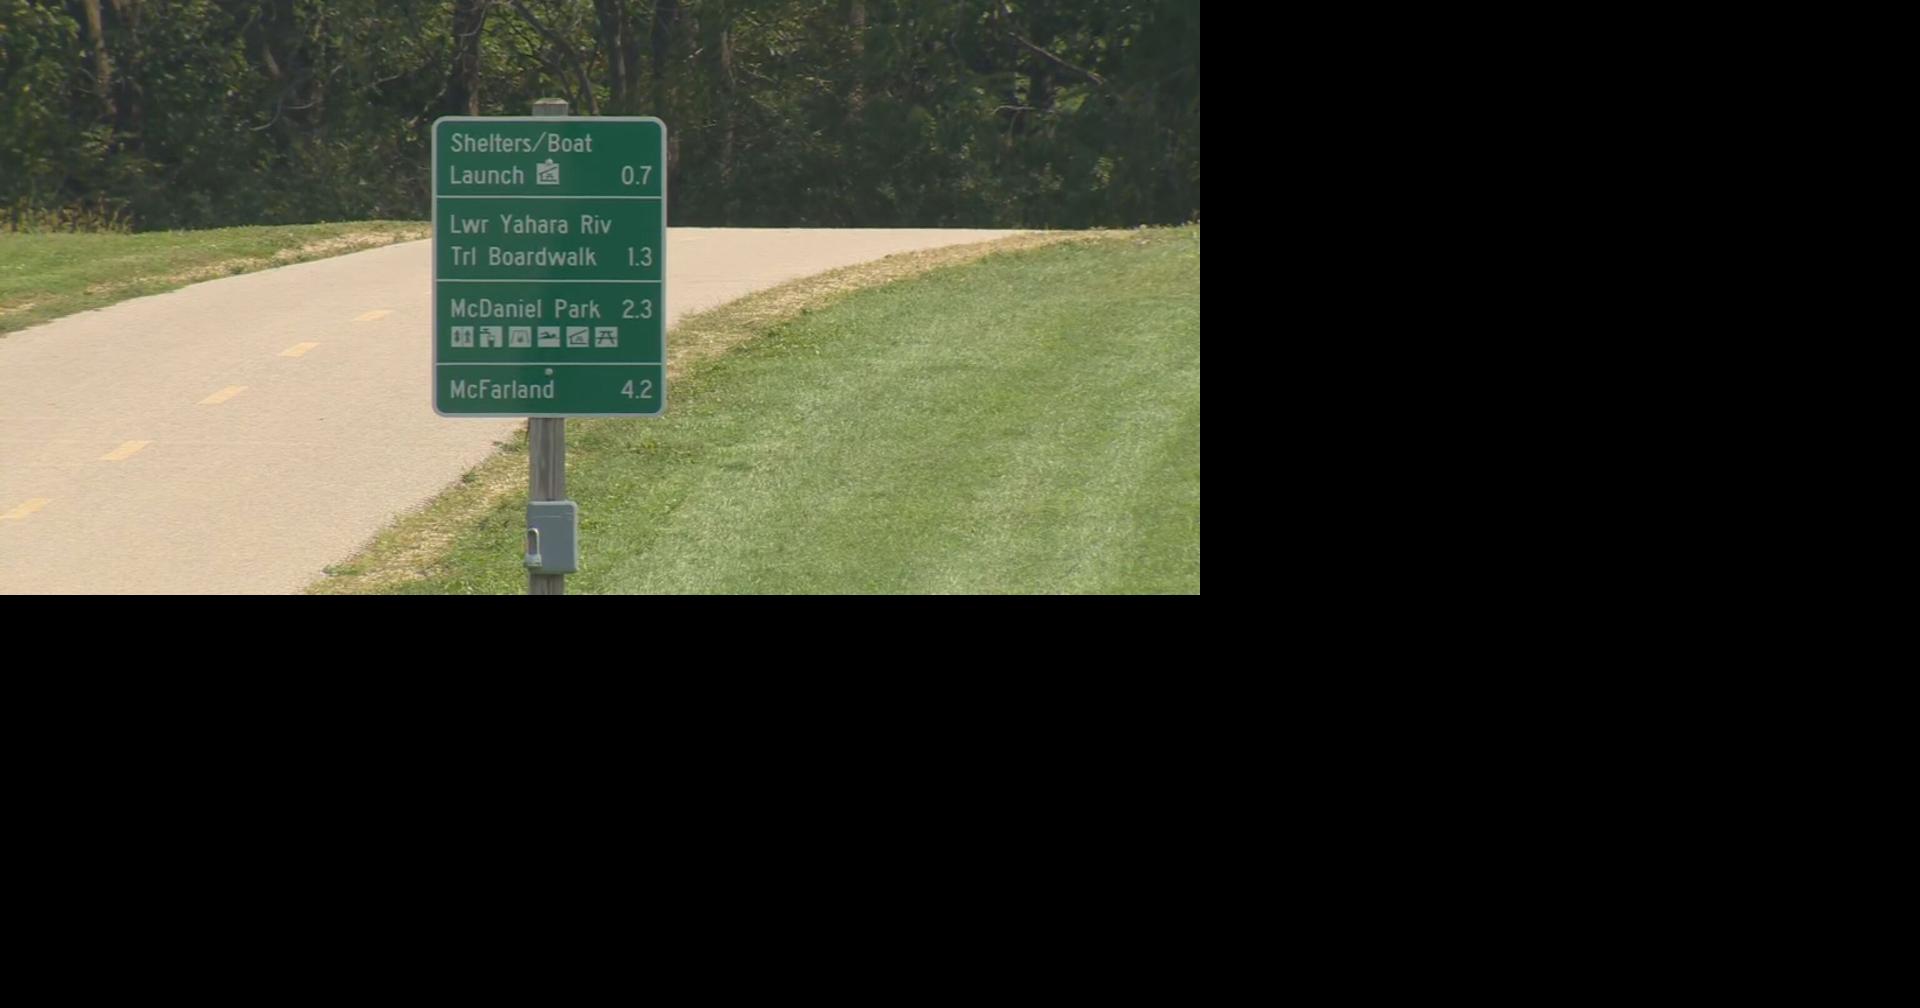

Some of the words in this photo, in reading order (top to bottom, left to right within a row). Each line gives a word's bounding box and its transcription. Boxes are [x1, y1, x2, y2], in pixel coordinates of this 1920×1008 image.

[451, 132, 593, 154] Shelters/Boat
[451, 165, 525, 185] Launch
[621, 165, 653, 185] 0.7
[451, 214, 489, 234] Lwr
[500, 214, 569, 234] Yahara
[581, 214, 611, 234] Riv
[451, 246, 477, 265] Trl
[489, 246, 598, 266] Boardwalk
[628, 246, 653, 266] 1.3
[451, 298, 542, 318] McDaniel
[555, 299, 601, 318] Park
[622, 299, 653, 319] 2.3
[450, 379, 555, 399] McFarland
[621, 379, 653, 399] 4.2
